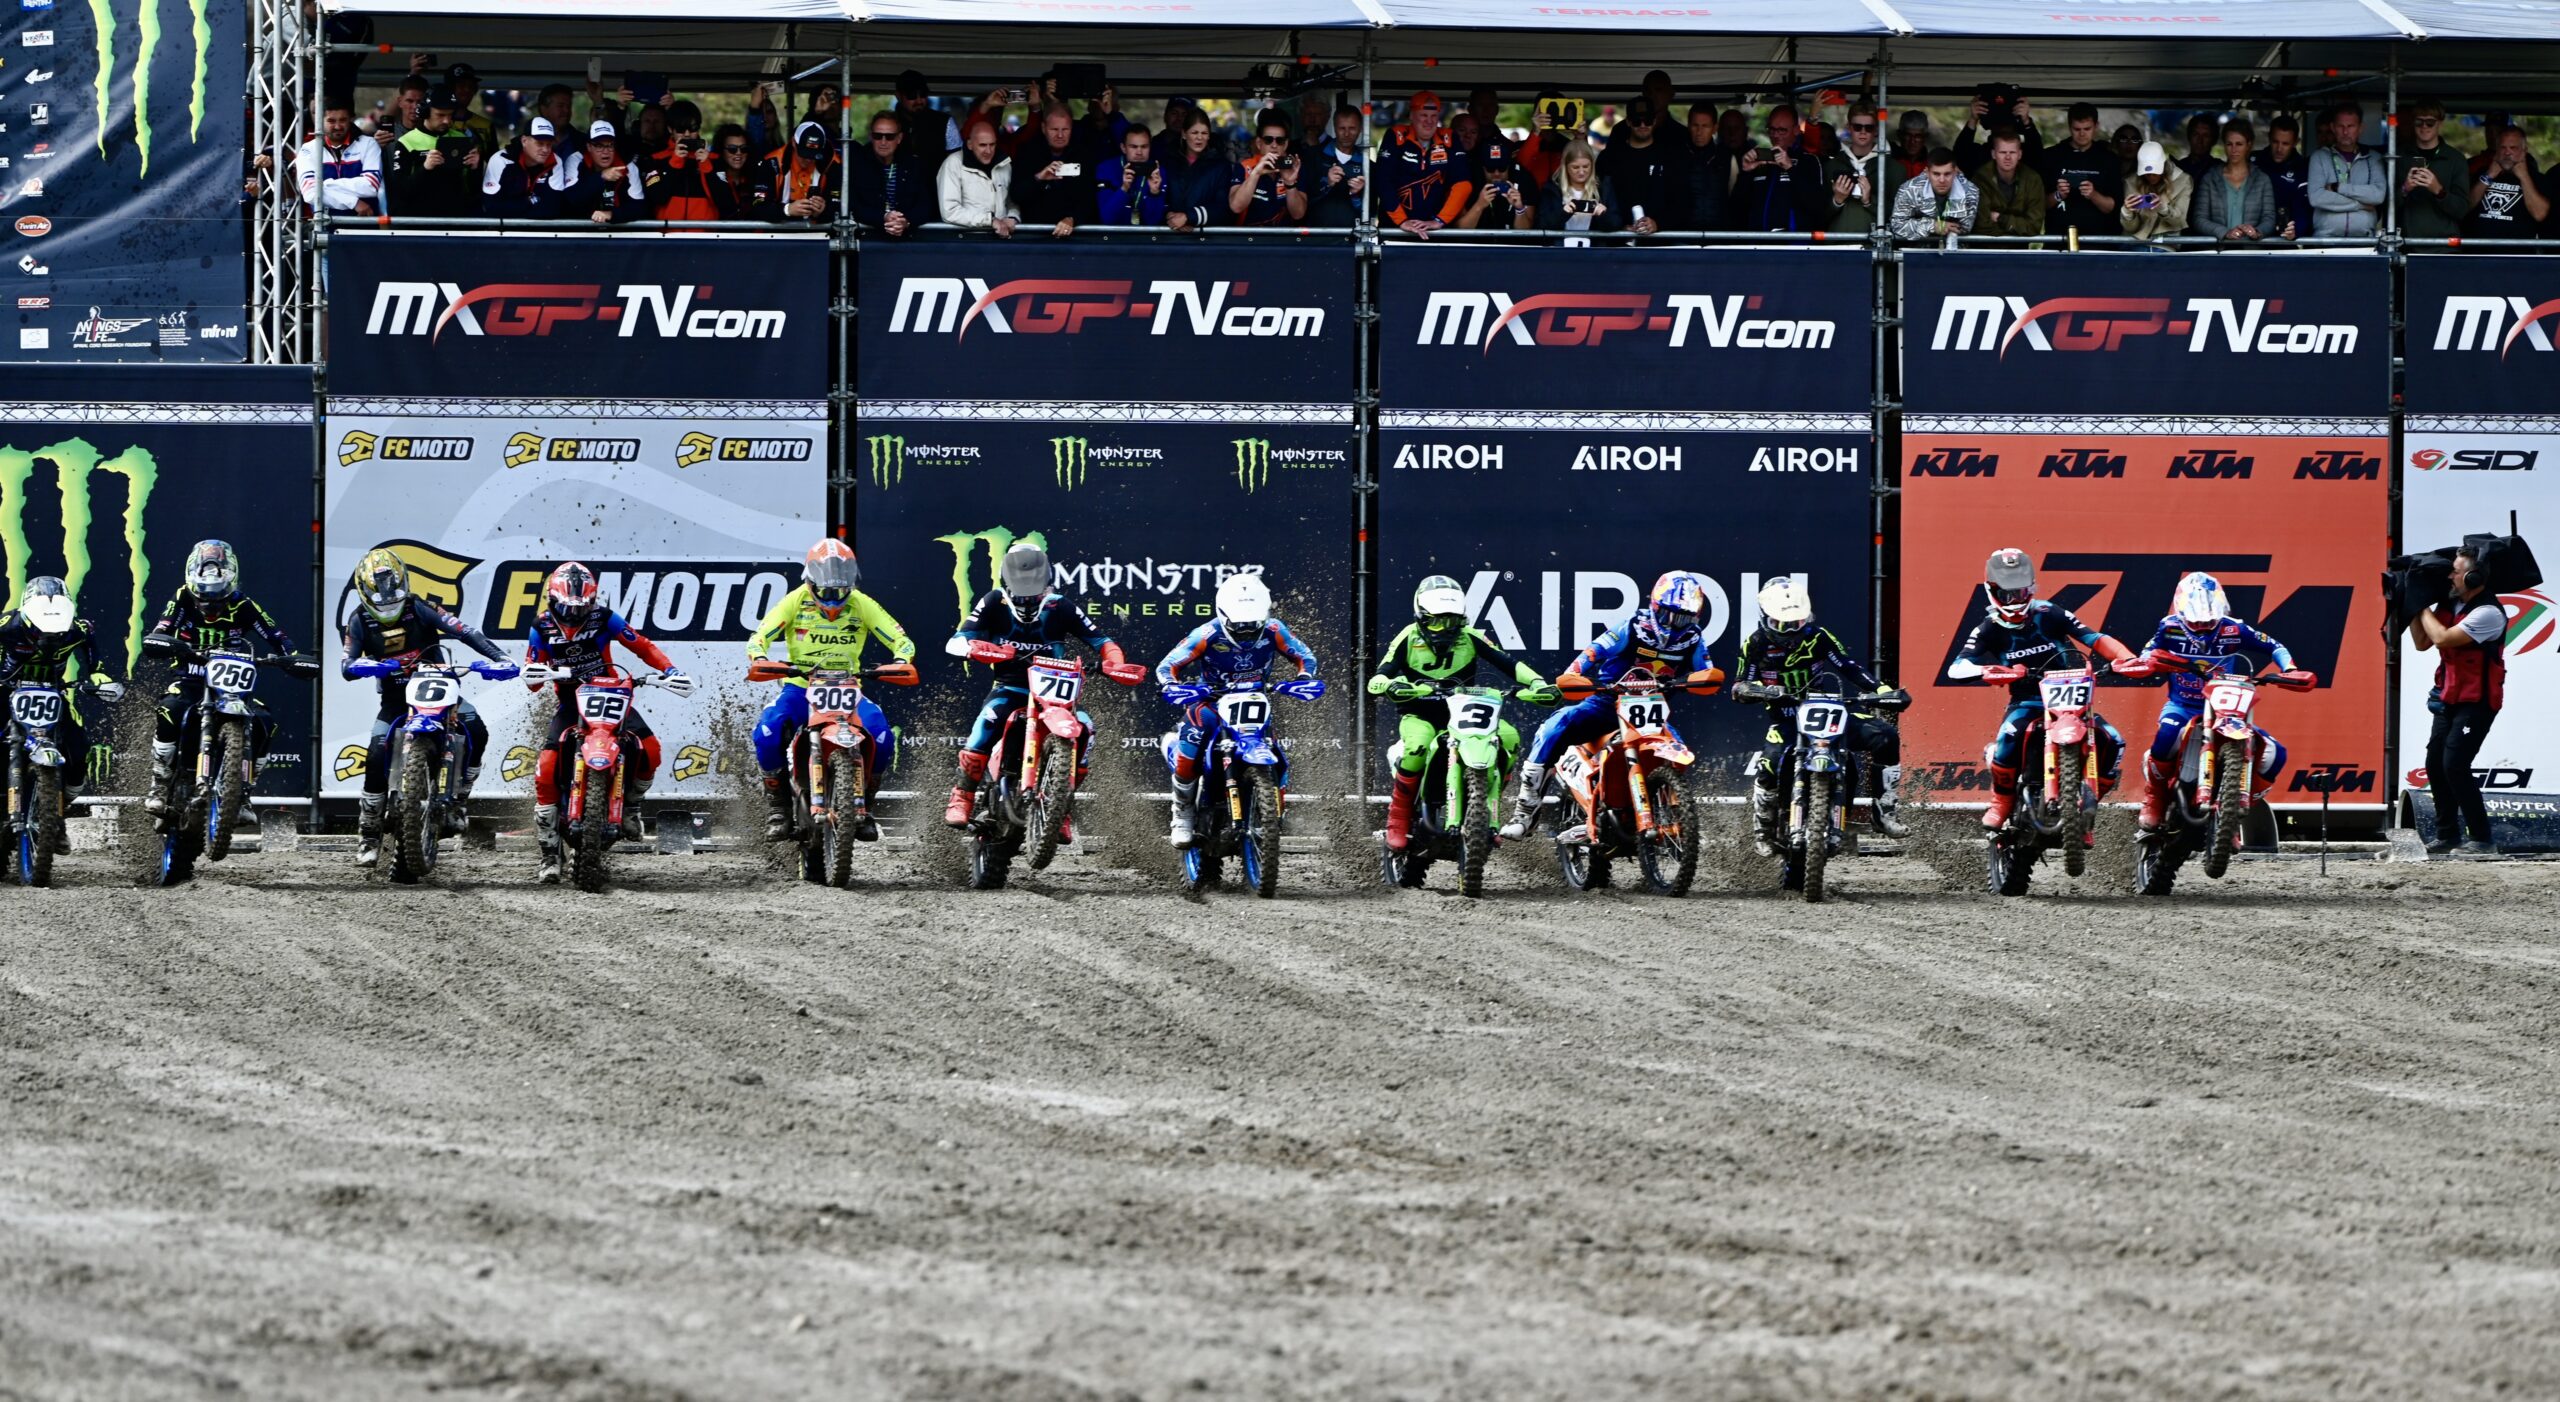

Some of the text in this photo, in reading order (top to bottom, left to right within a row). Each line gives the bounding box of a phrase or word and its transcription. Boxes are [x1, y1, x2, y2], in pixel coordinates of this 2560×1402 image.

[1531, 7, 1713, 16] TERRACE
[2045, 14, 2224, 22] TERRACE
[905, 445, 981, 458] MONSTER
[1088, 446, 1164, 460] MONSTER
[1271, 447, 1346, 461] MONSTER
[1394, 445, 1503, 469] AIROH
[1571, 446, 1682, 471] AIROH
[1749, 447, 1858, 472] AIROH
[1911, 448, 1999, 476] KTM
[2039, 449, 2127, 477] KTM
[2449, 450, 2539, 471] SIDI
[2167, 450, 2254, 479] KTM
[2294, 451, 2381, 479] KTM
[1087, 603, 1212, 616] ENERG
[549, 629, 598, 645] KENY
[810, 634, 857, 645] YUASA
[1000, 638, 1053, 651] HONDA
[2006, 642, 2056, 659] HONDA
[212, 662, 256, 690] 259
[1039, 676, 1075, 699] 70
[2176, 673, 2200, 689] Red
[414, 679, 449, 702] 6
[813, 688, 857, 710] 303
[2048, 686, 2090, 708] 243
[2210, 686, 2254, 711] 61
[16, 694, 61, 721] 959
[584, 696, 625, 720] 92
[1228, 701, 1267, 726] 10
[1458, 703, 1494, 729] 3
[1629, 704, 1664, 728] 84
[1804, 707, 1843, 732] 91
[1562, 755, 1581, 779] 84
[2288, 763, 2376, 792] KTM
[2486, 799, 2558, 812] ONSTER
